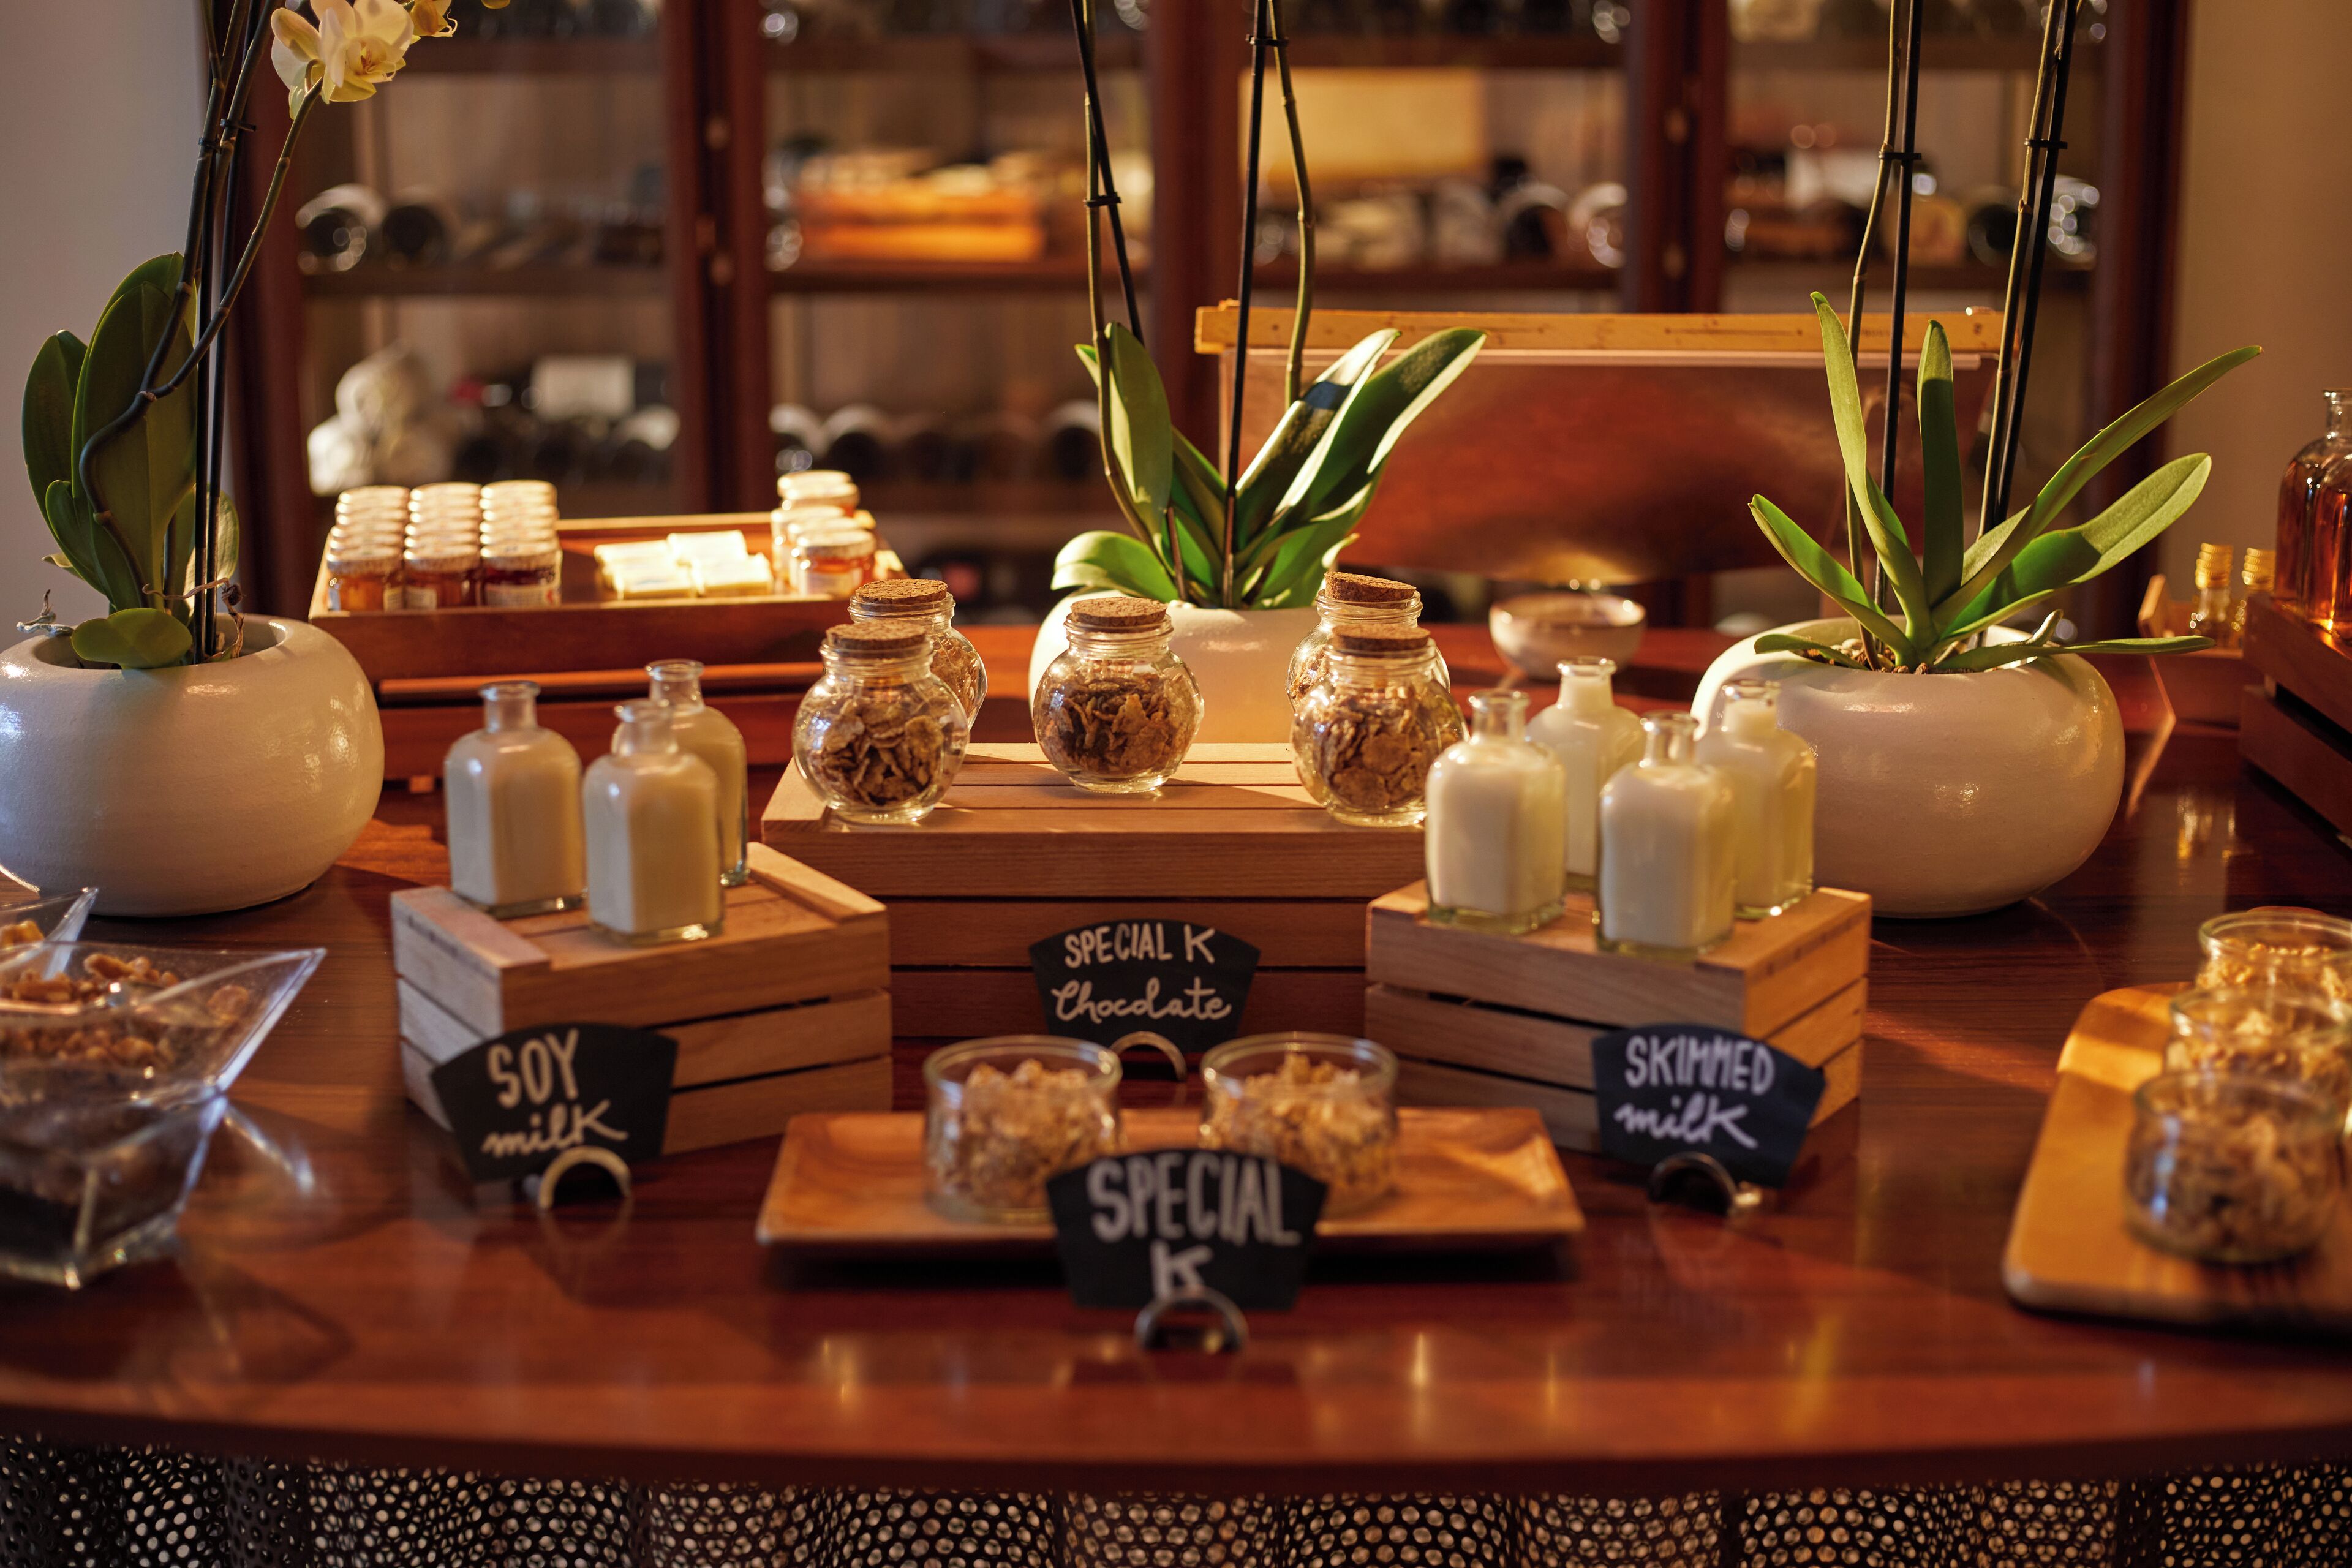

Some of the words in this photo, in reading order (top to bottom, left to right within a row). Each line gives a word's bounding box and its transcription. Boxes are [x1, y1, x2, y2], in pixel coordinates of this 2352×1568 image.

[1064, 922, 1174, 968] SPECIAL
[1183, 923, 1216, 965] K
[1050, 976, 1233, 1024] Chocolate
[486, 1027, 579, 1109] SOY
[1624, 1034, 1776, 1095] SKIMMED
[1086, 1151, 1302, 1246] SPECIAL
[1150, 1238, 1214, 1300] K
